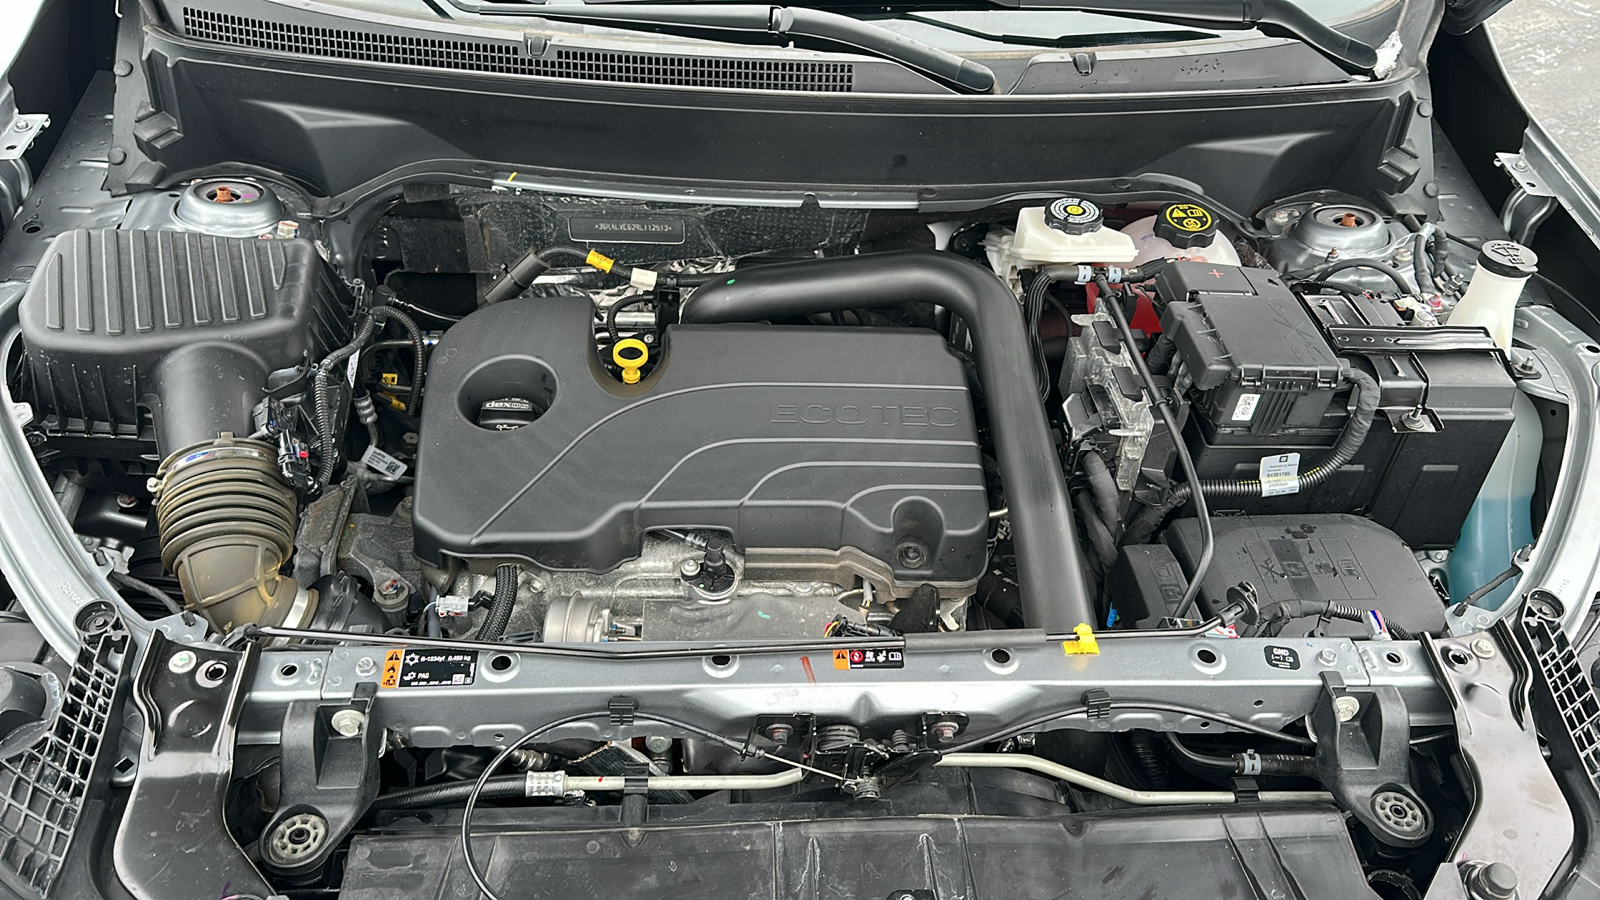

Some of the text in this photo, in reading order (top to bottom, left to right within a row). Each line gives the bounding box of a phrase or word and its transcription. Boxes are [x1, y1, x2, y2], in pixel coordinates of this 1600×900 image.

[485, 401, 529, 409] dexos
[770, 404, 960, 427] ECOTEC
[1273, 648, 1289, 656] GND
